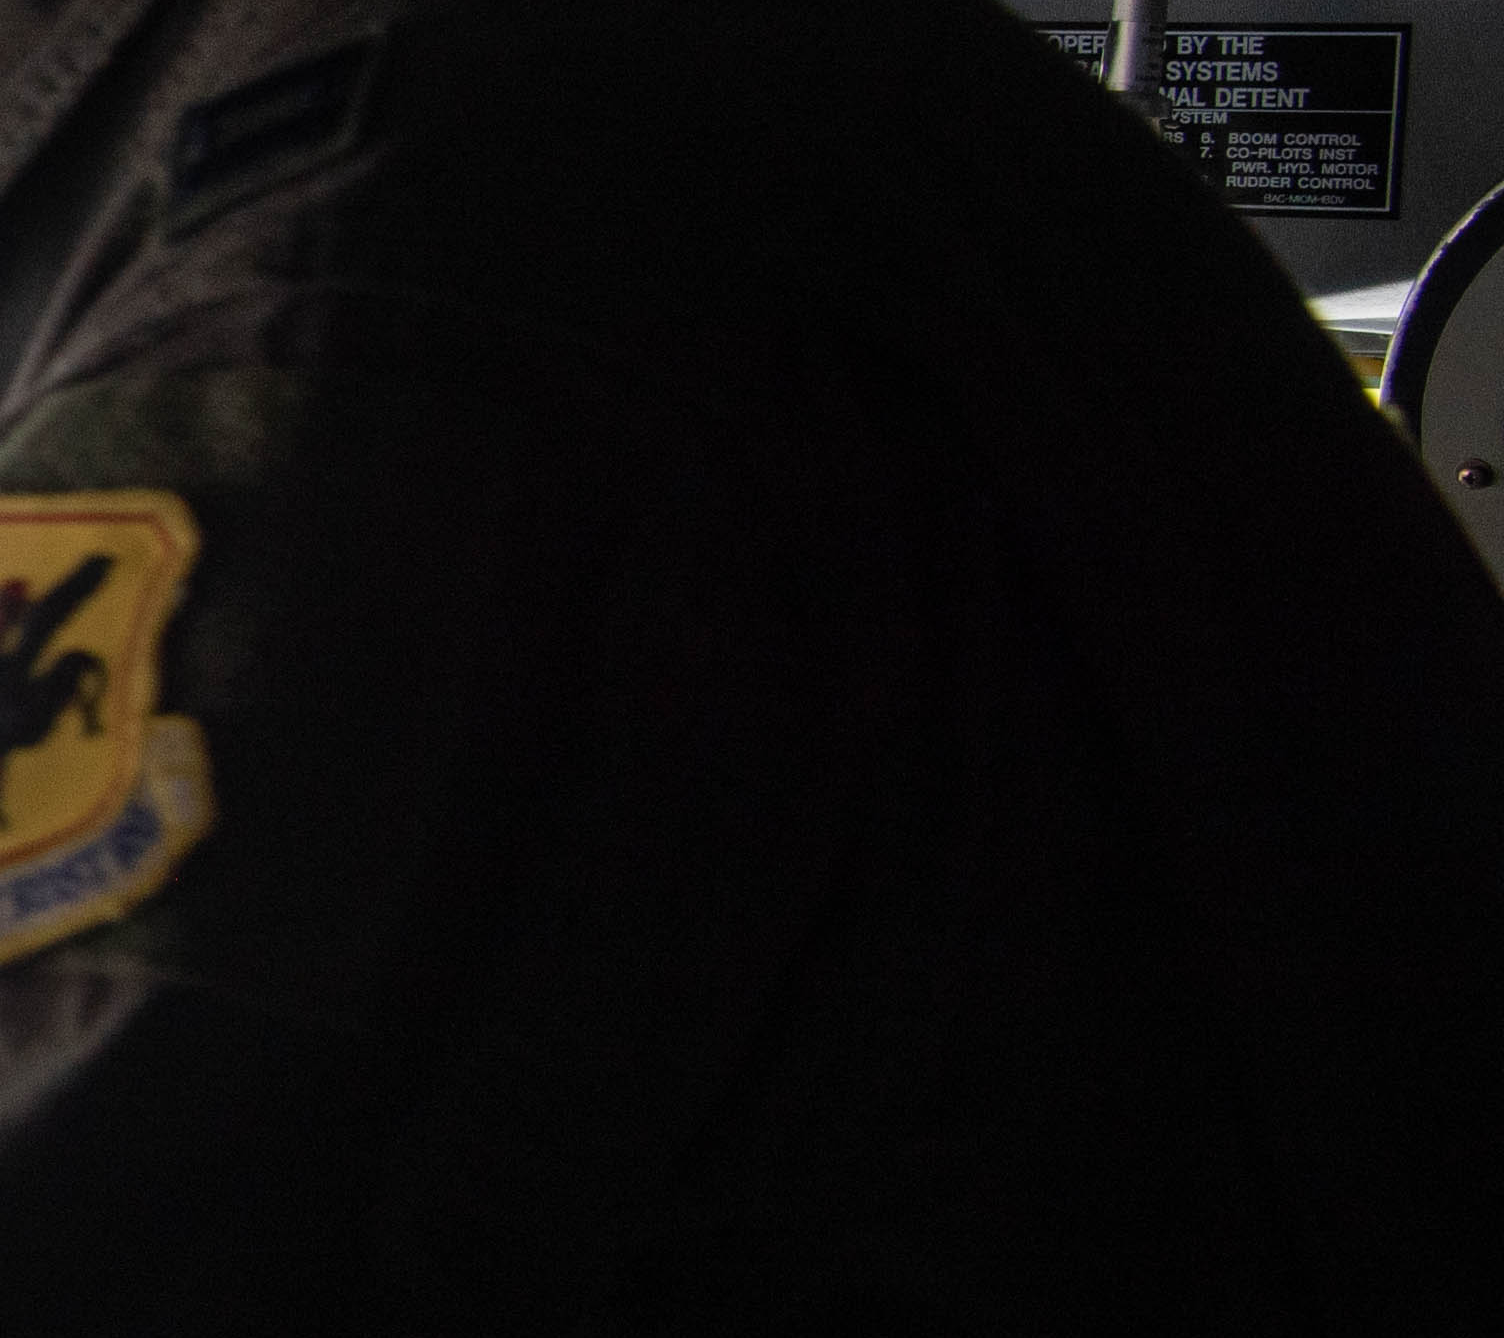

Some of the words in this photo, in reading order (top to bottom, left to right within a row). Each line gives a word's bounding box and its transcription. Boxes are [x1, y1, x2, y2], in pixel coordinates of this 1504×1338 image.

[1177, 36, 1207, 56] BY
[1217, 35, 1265, 56] THE
[1165, 62, 1279, 82] SYSTEMS
[1214, 87, 1311, 109] DETENT
[1227, 132, 1278, 146] BOOM
[1284, 133, 1363, 147] CONTROL
[1226, 147, 1312, 160] CO-PILOTS
[1319, 148, 1357, 161] INST
[1231, 162, 1272, 176] PWR.
[1277, 162, 1316, 176] HYD.
[1321, 163, 1379, 176] MOTOR
[1225, 176, 1291, 190] RUDDER
[1298, 177, 1377, 191] CONTROL
